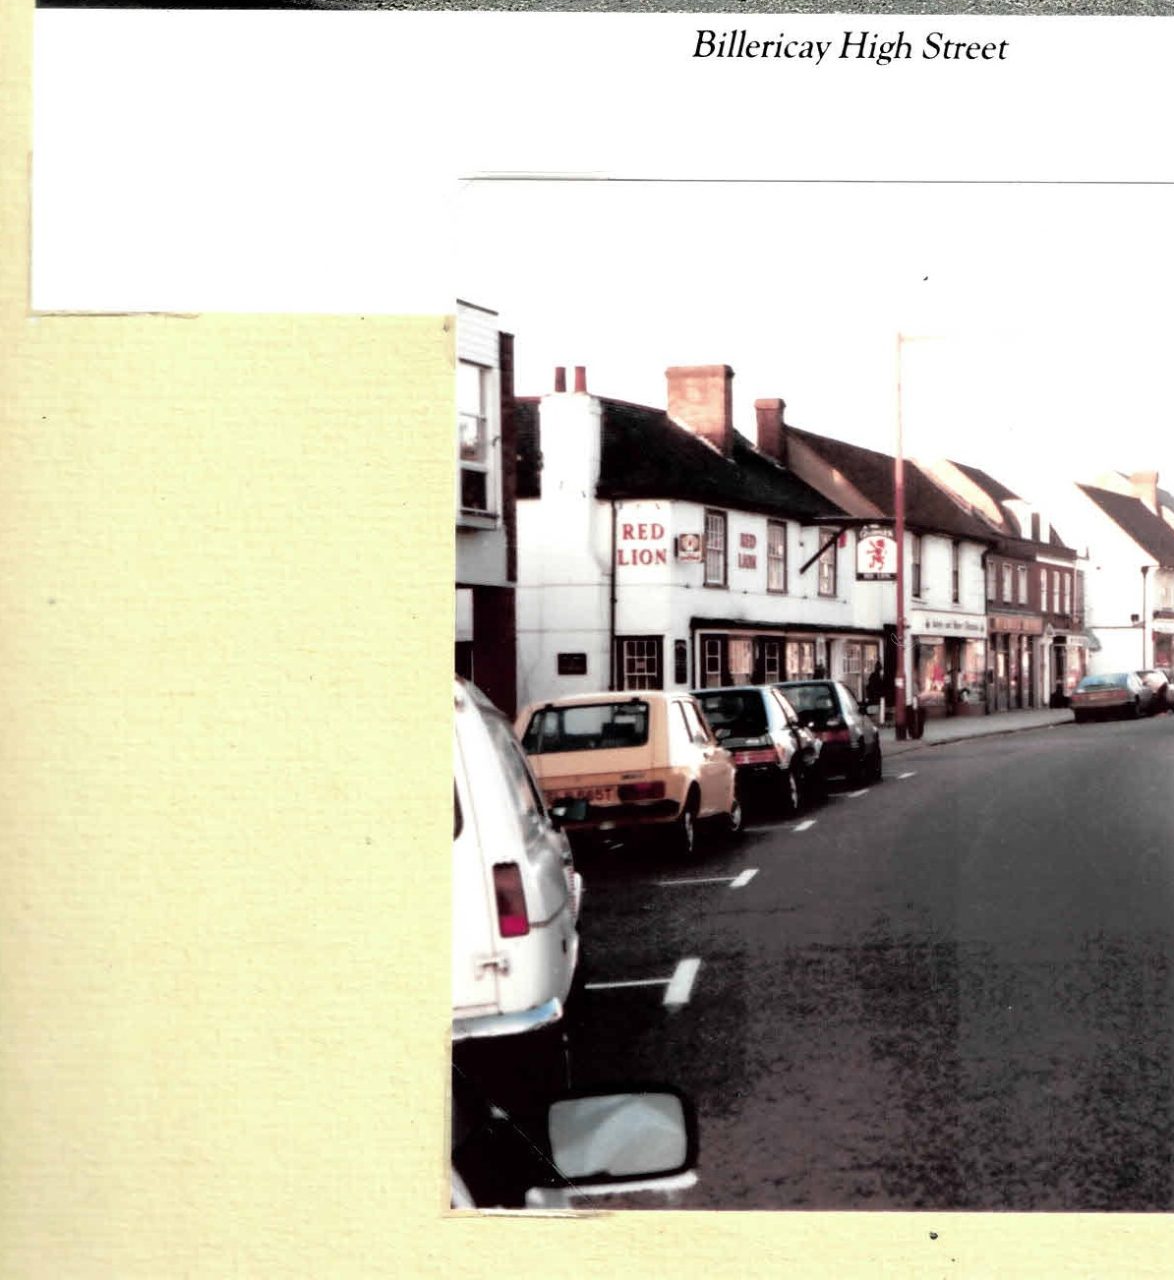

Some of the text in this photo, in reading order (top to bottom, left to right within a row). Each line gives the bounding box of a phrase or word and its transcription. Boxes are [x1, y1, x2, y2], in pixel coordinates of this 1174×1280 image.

[692, 28, 1010, 66] Billericay High Street
[622, 523, 664, 540] RED
[618, 549, 667, 566] LION
